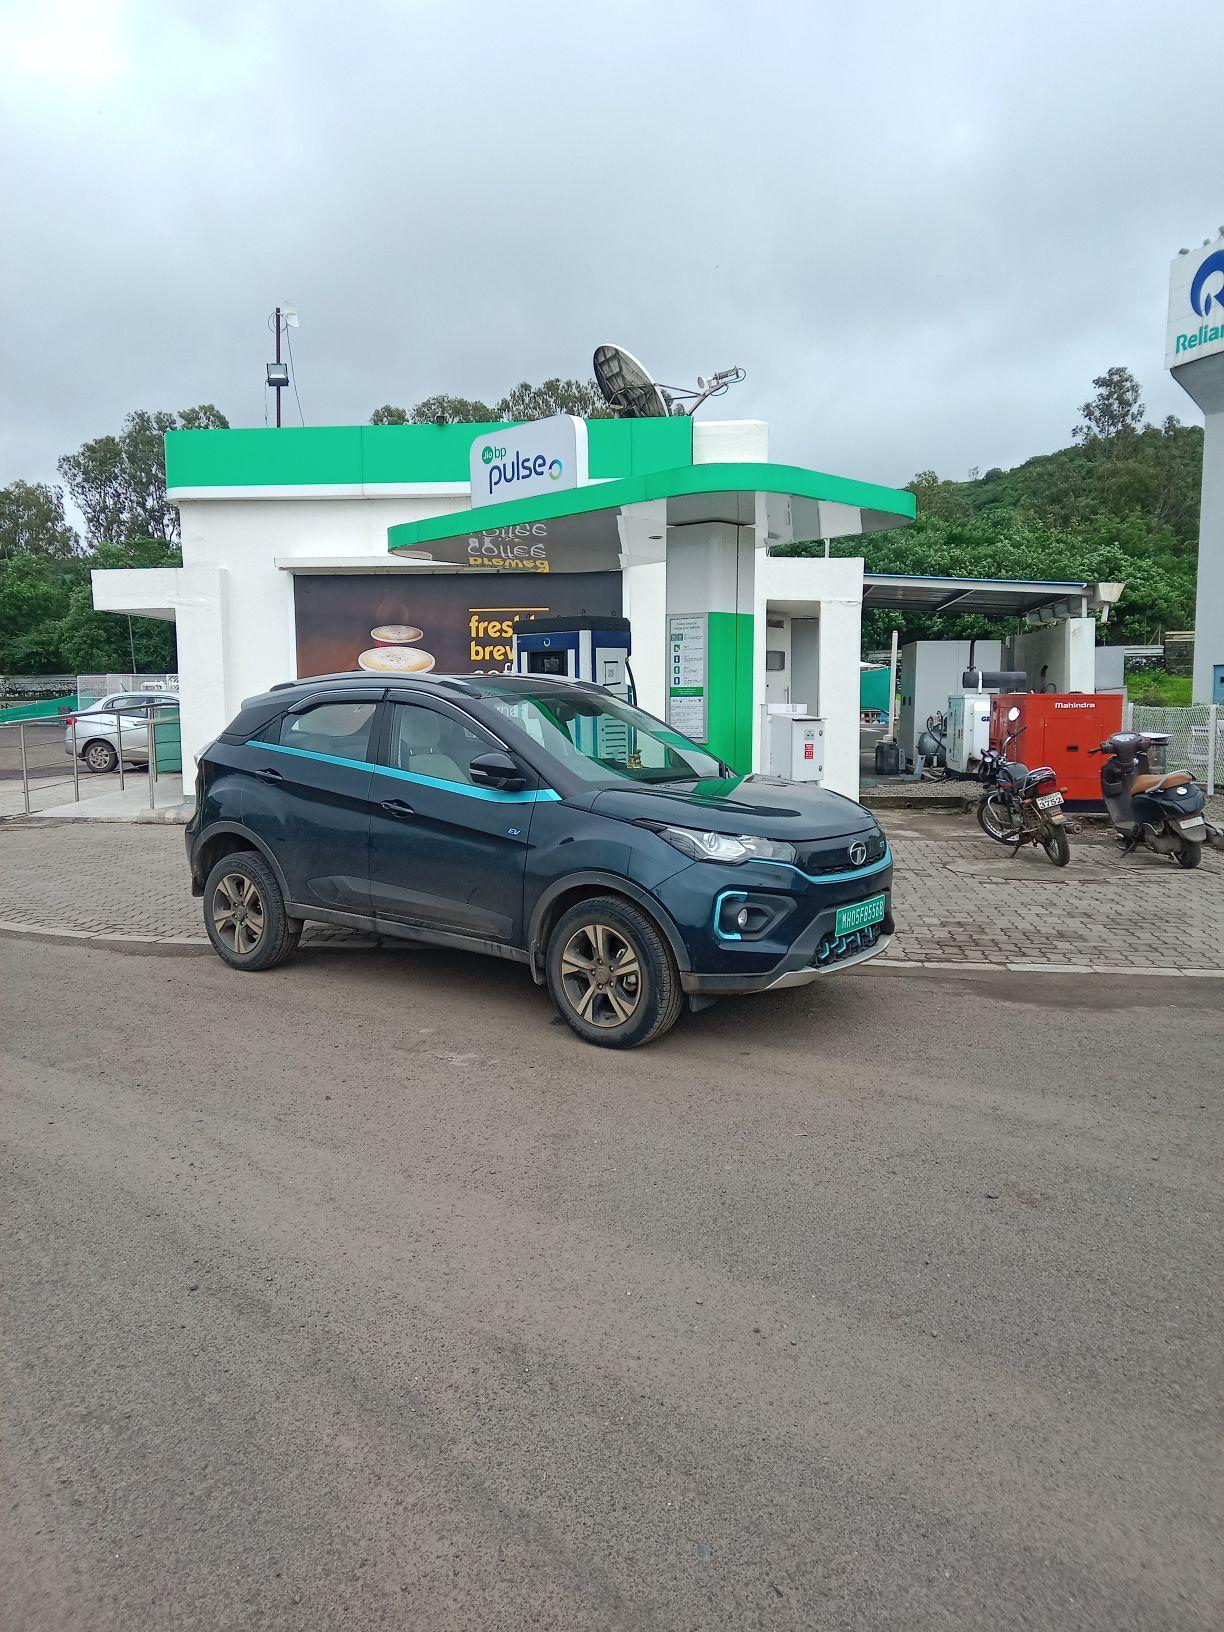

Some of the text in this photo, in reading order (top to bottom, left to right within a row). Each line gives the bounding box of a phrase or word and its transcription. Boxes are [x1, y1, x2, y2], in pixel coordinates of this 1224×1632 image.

[494, 446, 507, 460] bp
[489, 451, 546, 495] pulse
[508, 827, 520, 835] EV
